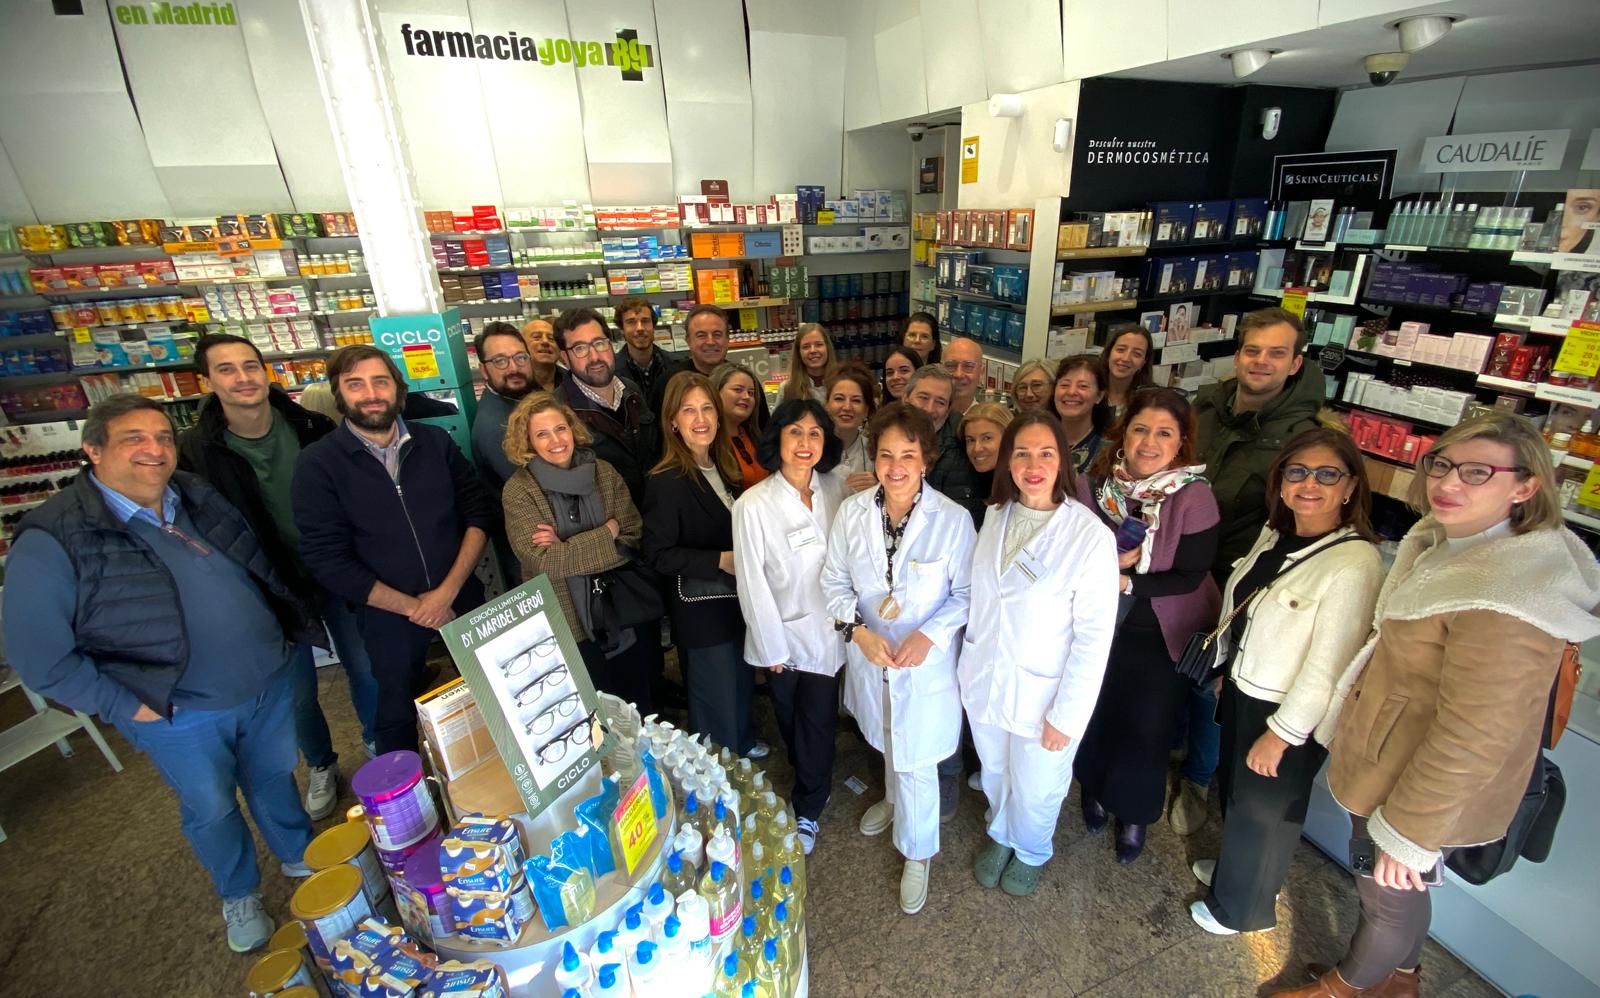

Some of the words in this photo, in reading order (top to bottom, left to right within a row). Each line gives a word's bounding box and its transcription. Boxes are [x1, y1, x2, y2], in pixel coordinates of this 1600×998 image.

[115, 4, 148, 25] en
[152, 2, 237, 25] Madrid
[612, 38, 648, 72] 89
[1087, 149, 1209, 164] DERMOCOSMÉTICA
[1088, 137, 1124, 148] Descubre
[1127, 139, 1156, 148] nuestra
[1436, 135, 1547, 164] CAUDALÍE
[381, 329, 441, 346] CICLO
[461, 630, 474, 648] BY
[475, 608, 518, 641] MARIBEL
[516, 589, 544, 617] VERDÚ
[469, 605, 498, 626] EDICIÓN
[497, 591, 527, 610] LIMITADA
[557, 757, 590, 789] CICLO
[461, 827, 492, 836] Ensure
[628, 820, 643, 849] 40
